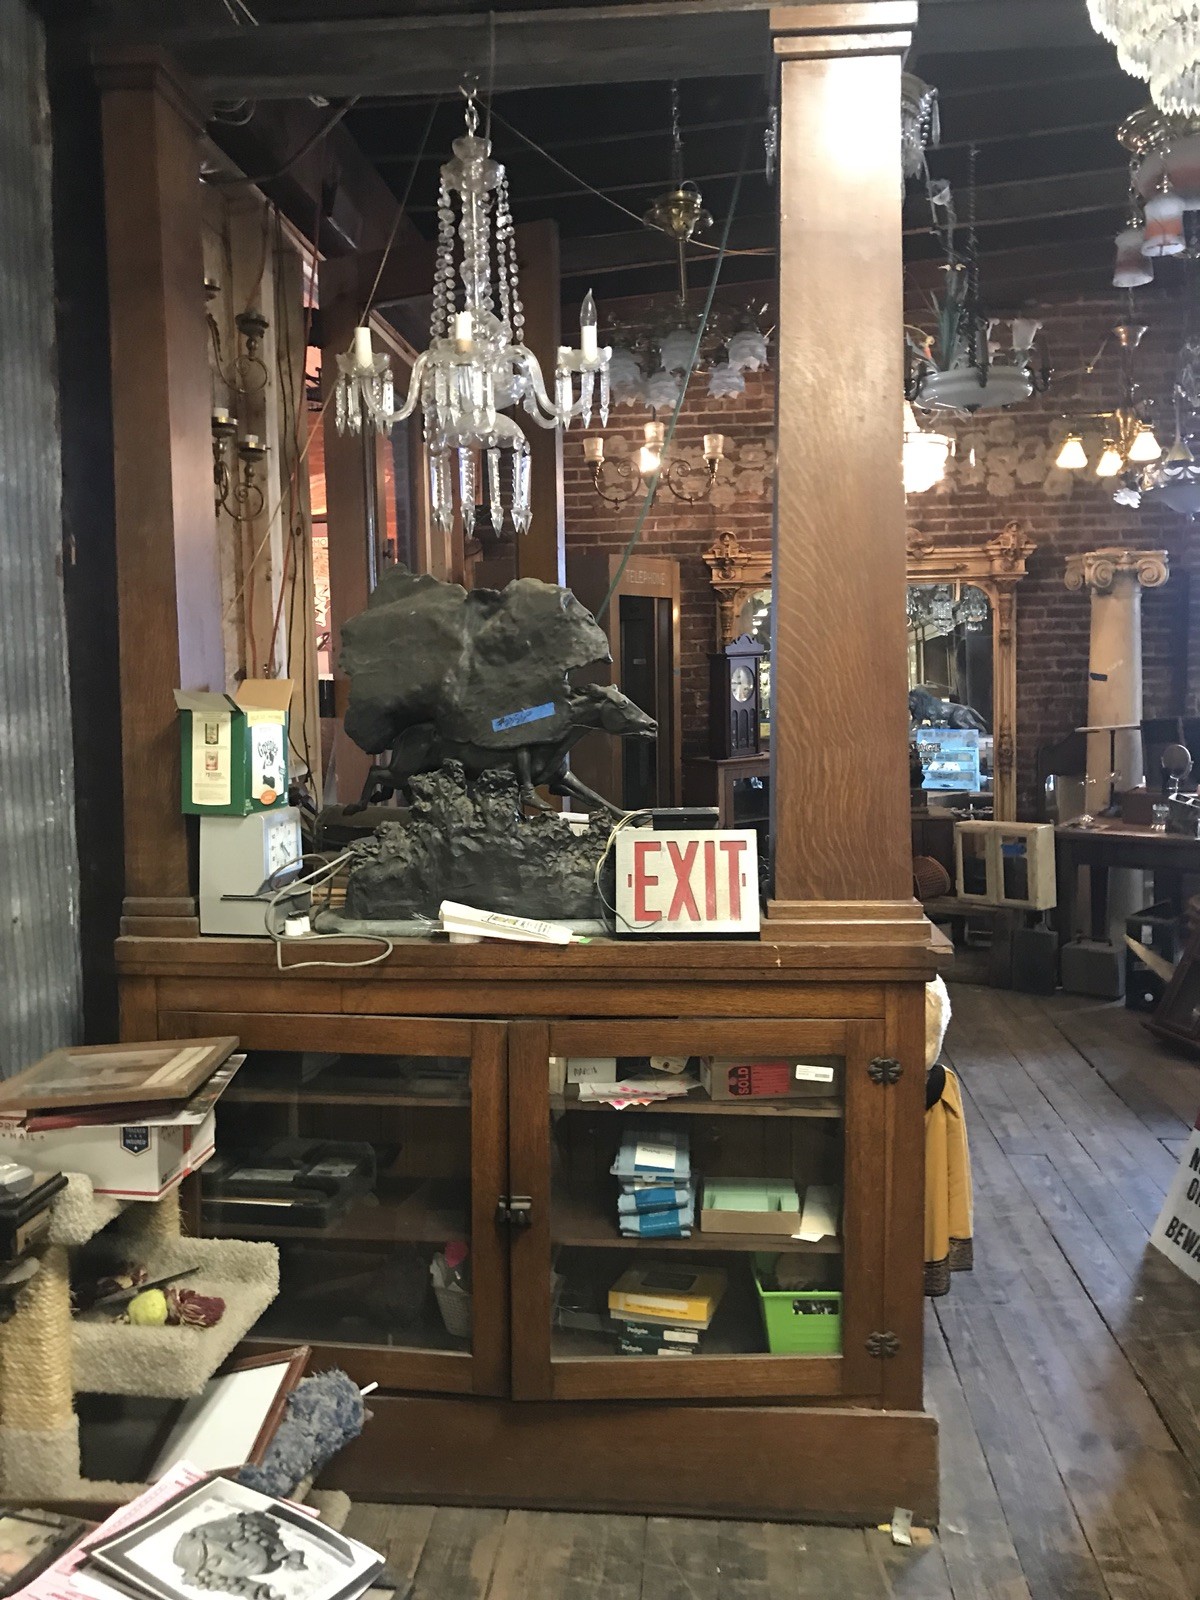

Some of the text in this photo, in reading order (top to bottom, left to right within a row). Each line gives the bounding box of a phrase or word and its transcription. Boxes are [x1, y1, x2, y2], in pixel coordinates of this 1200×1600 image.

[625, 569, 666, 586] TELEPHONE
[634, 840, 747, 921] EXIT
[737, 1067, 749, 1094] SOLD
[10, 1132, 35, 1141] MAIL
